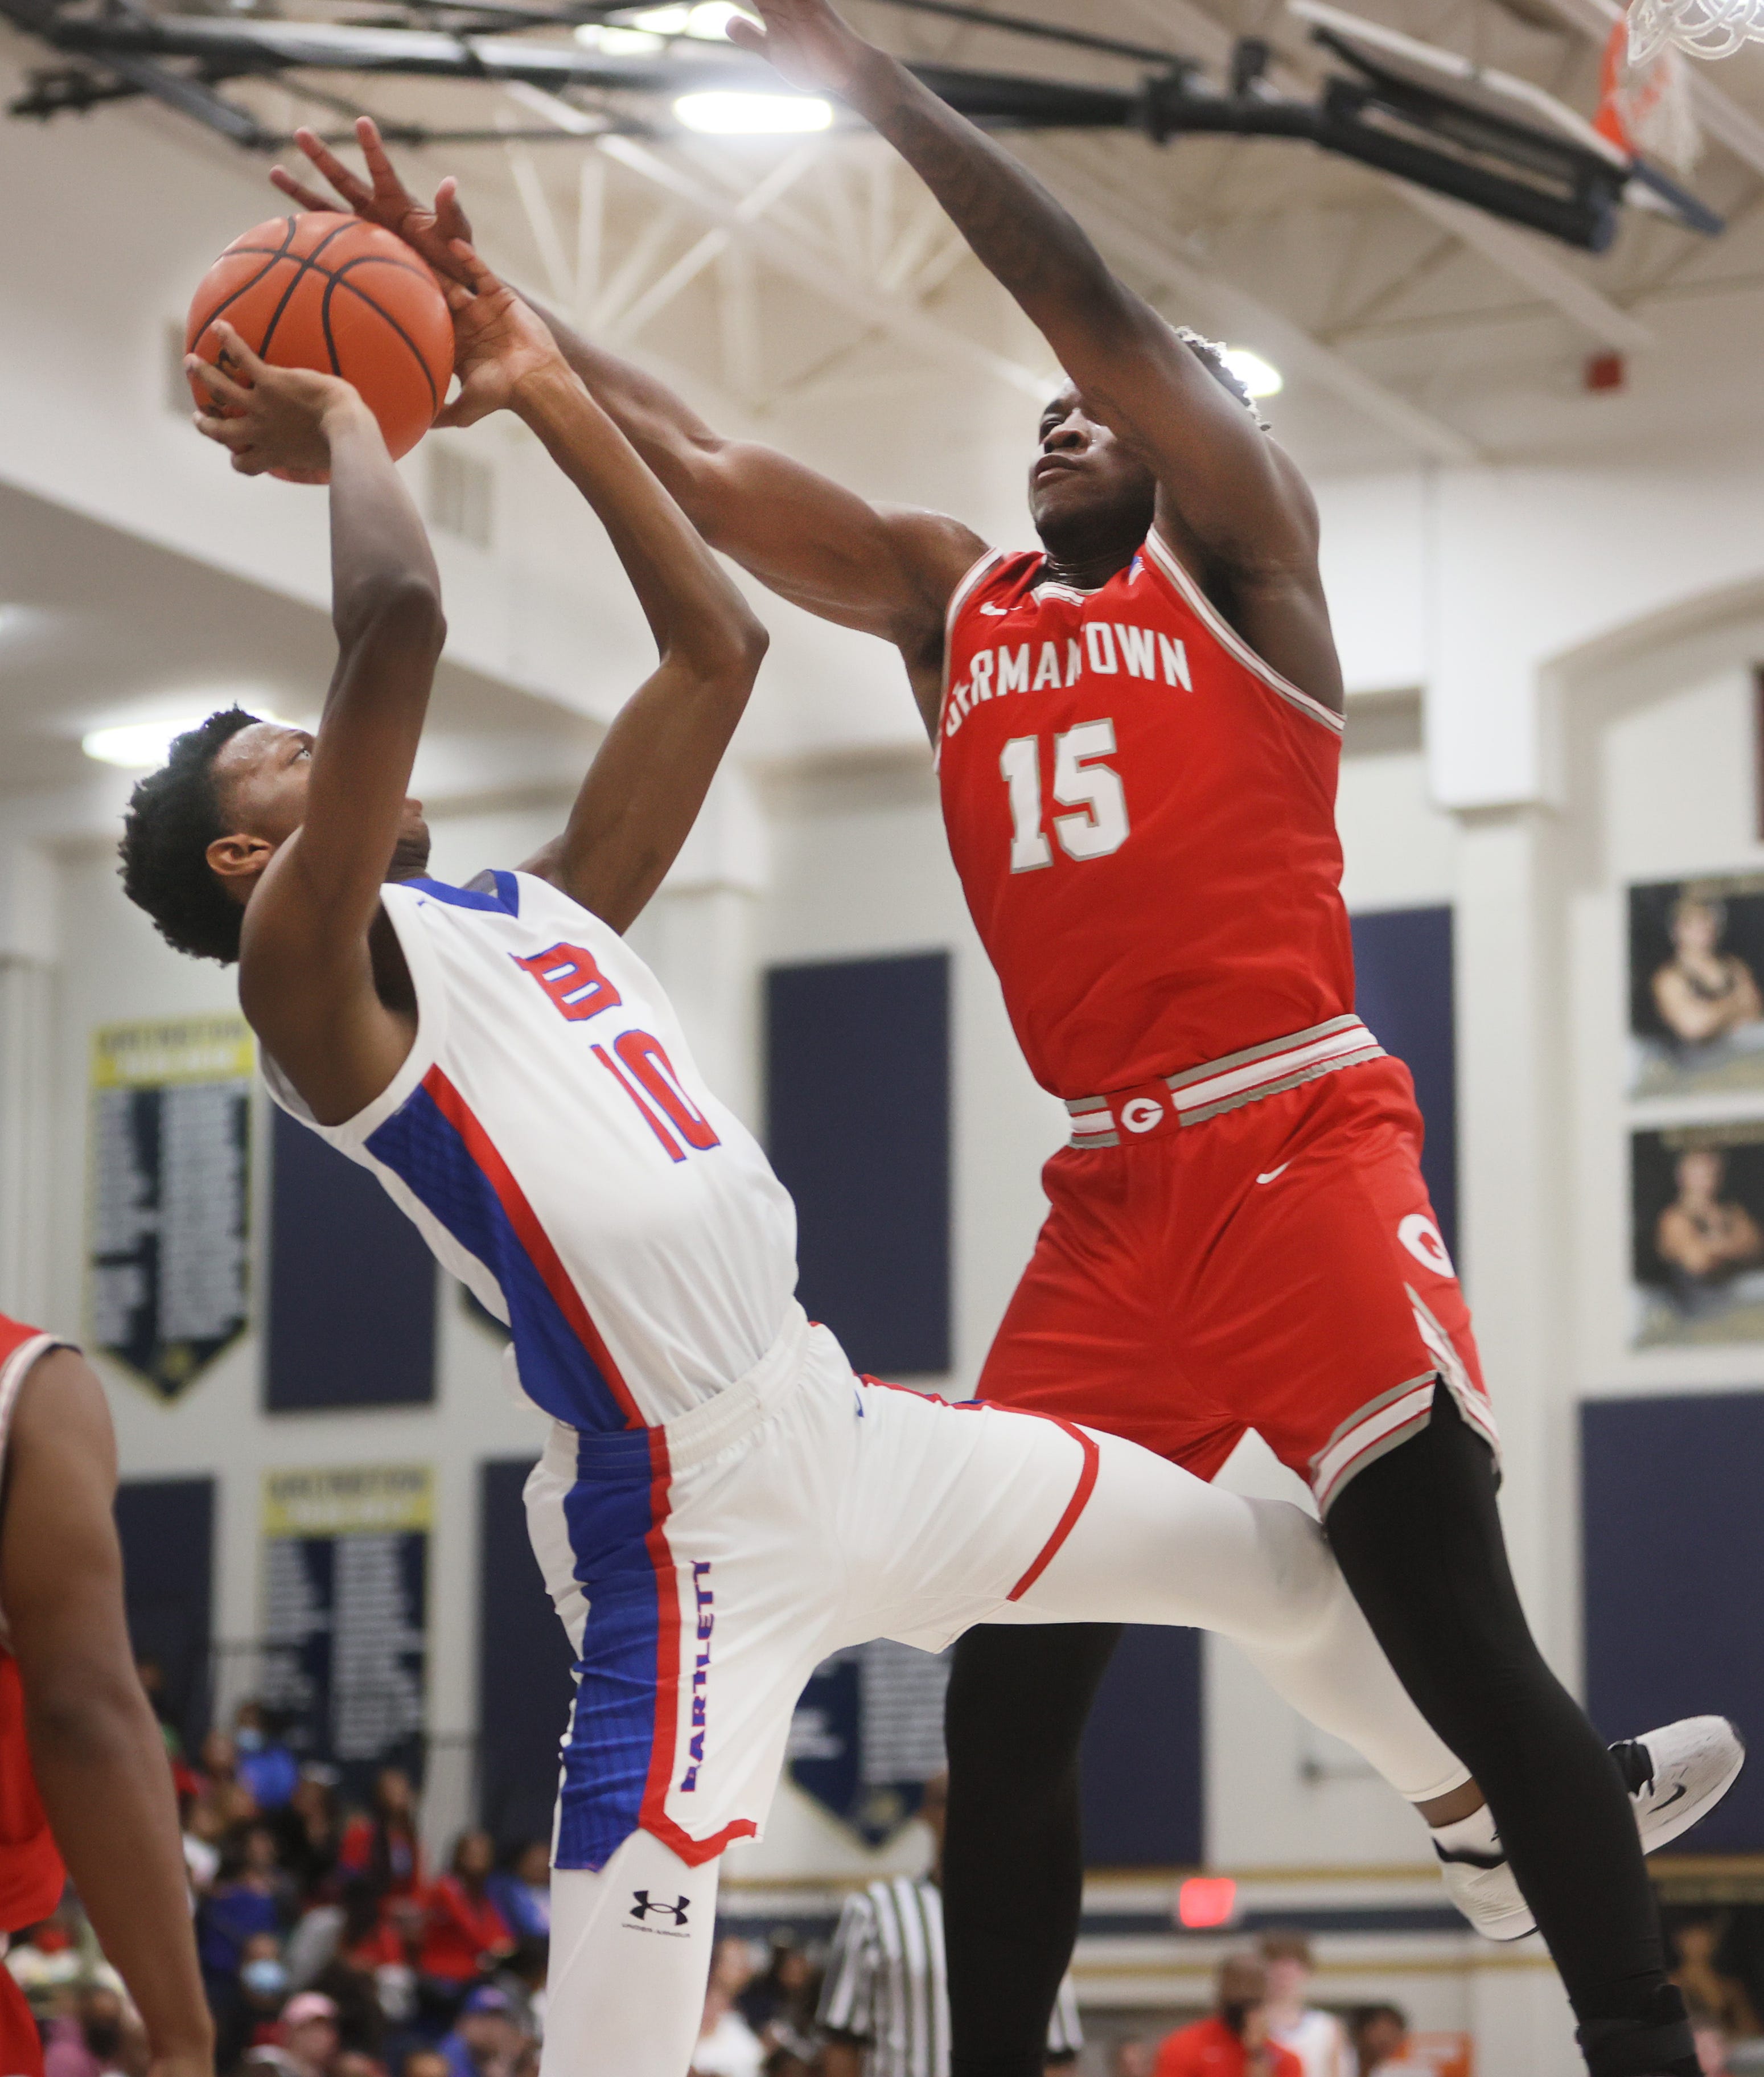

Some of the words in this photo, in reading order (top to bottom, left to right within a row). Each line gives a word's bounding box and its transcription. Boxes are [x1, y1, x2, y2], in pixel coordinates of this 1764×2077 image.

[945, 622, 1193, 737] RMANOWN
[1000, 717, 1130, 875] 15
[508, 942, 622, 1021] B
[589, 1029, 721, 1163] 10
[1121, 1098, 1163, 1133] G
